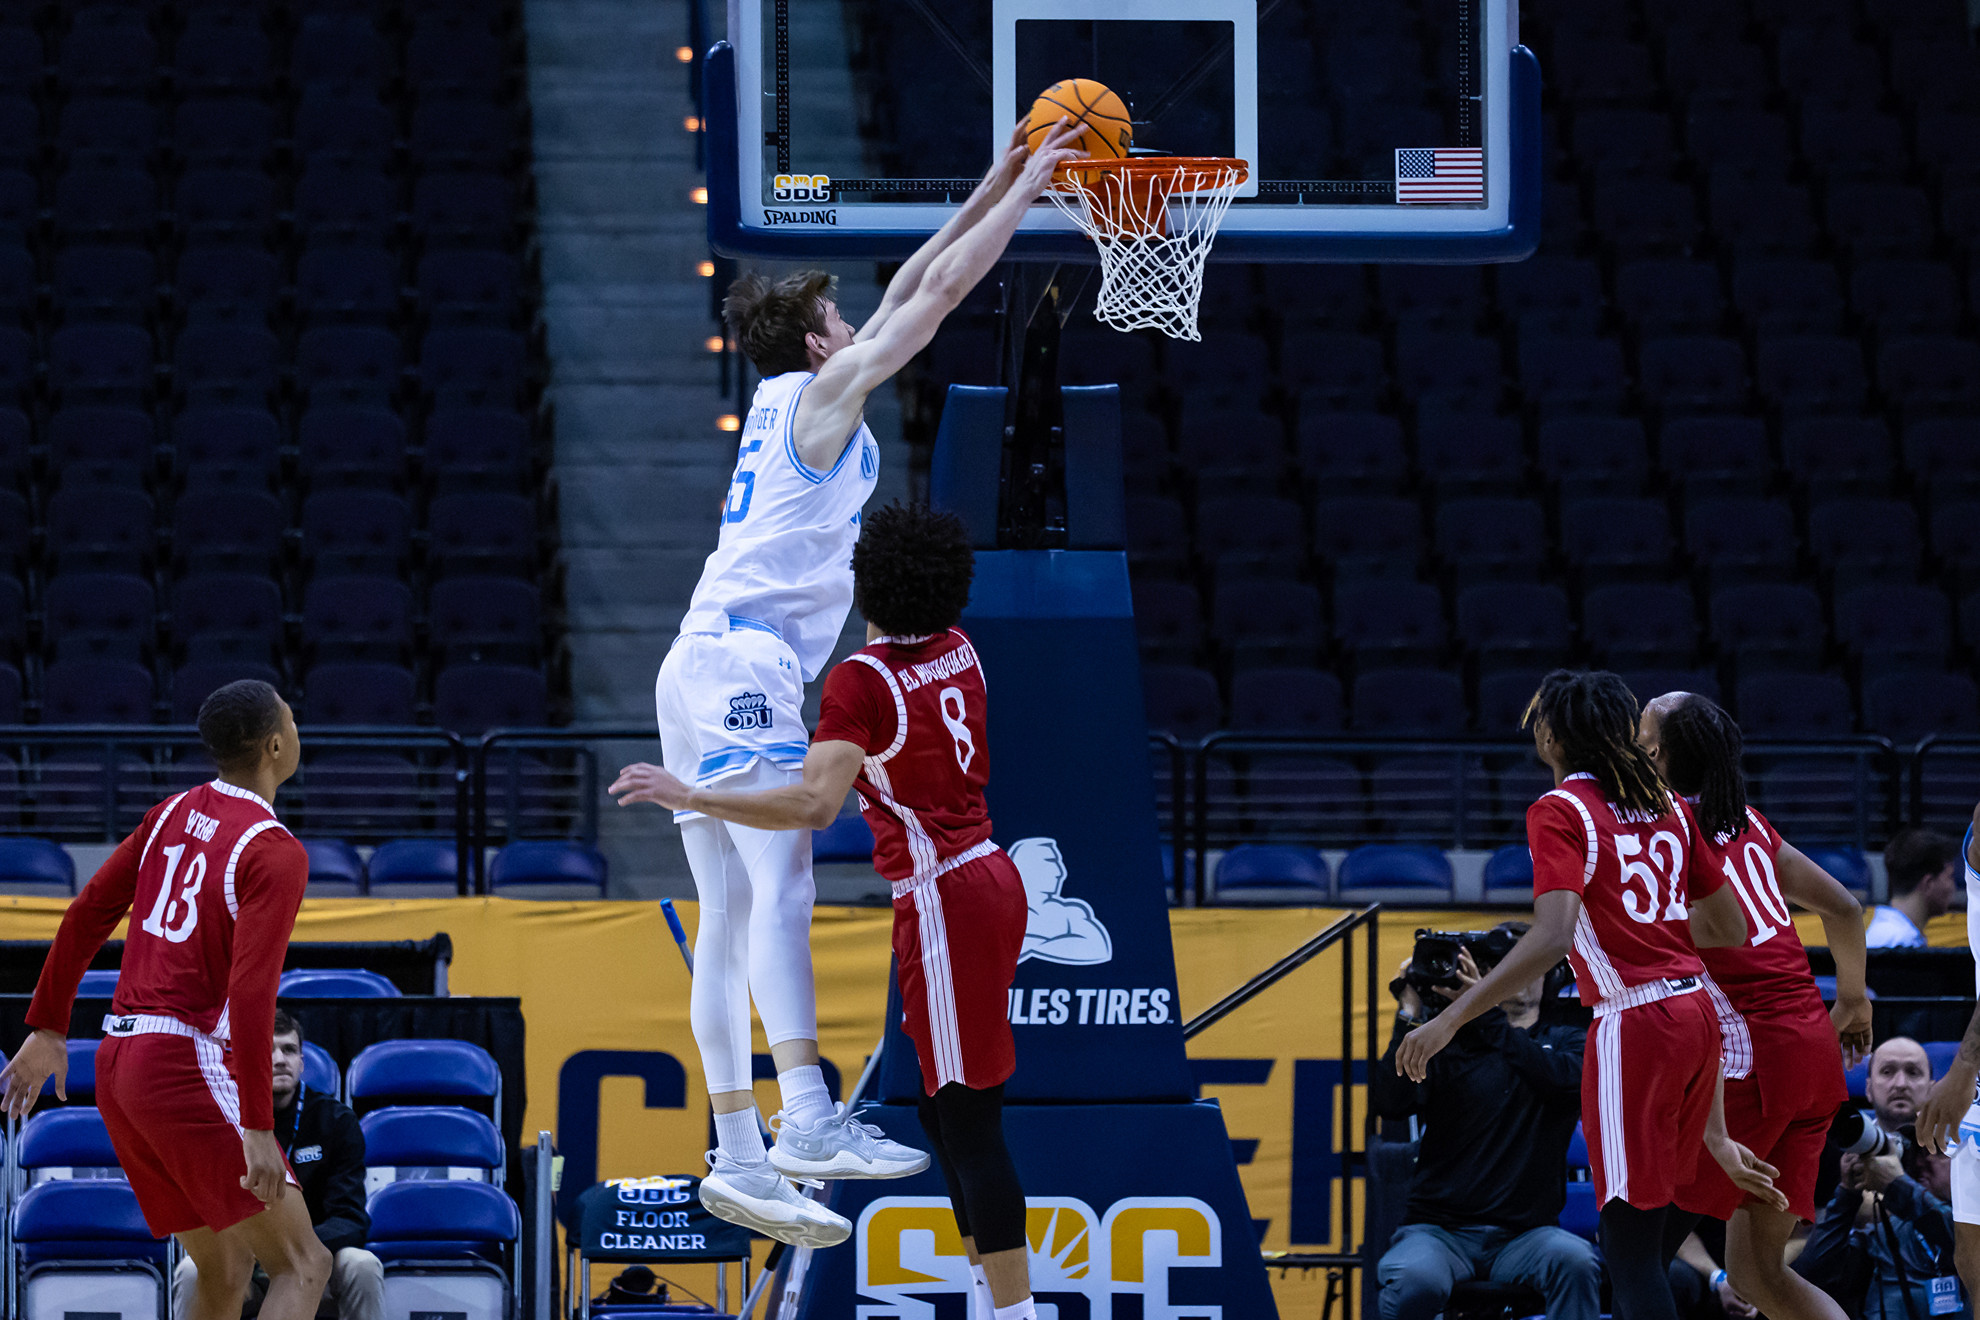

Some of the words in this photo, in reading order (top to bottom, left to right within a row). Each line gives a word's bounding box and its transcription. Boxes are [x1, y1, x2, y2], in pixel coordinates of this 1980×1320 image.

[774, 175, 829, 202] SBC
[764, 209, 837, 226] SPALDING
[724, 708, 773, 731] ODU
[939, 686, 975, 775] 8
[142, 843, 207, 943] 13
[1614, 831, 1689, 924] 52
[1722, 842, 1791, 947] 10
[1008, 988, 1071, 1025] LES
[1075, 988, 1171, 1025] TIRES
[616, 1210, 690, 1228] FLOOR
[600, 1233, 706, 1250] CLEANER
